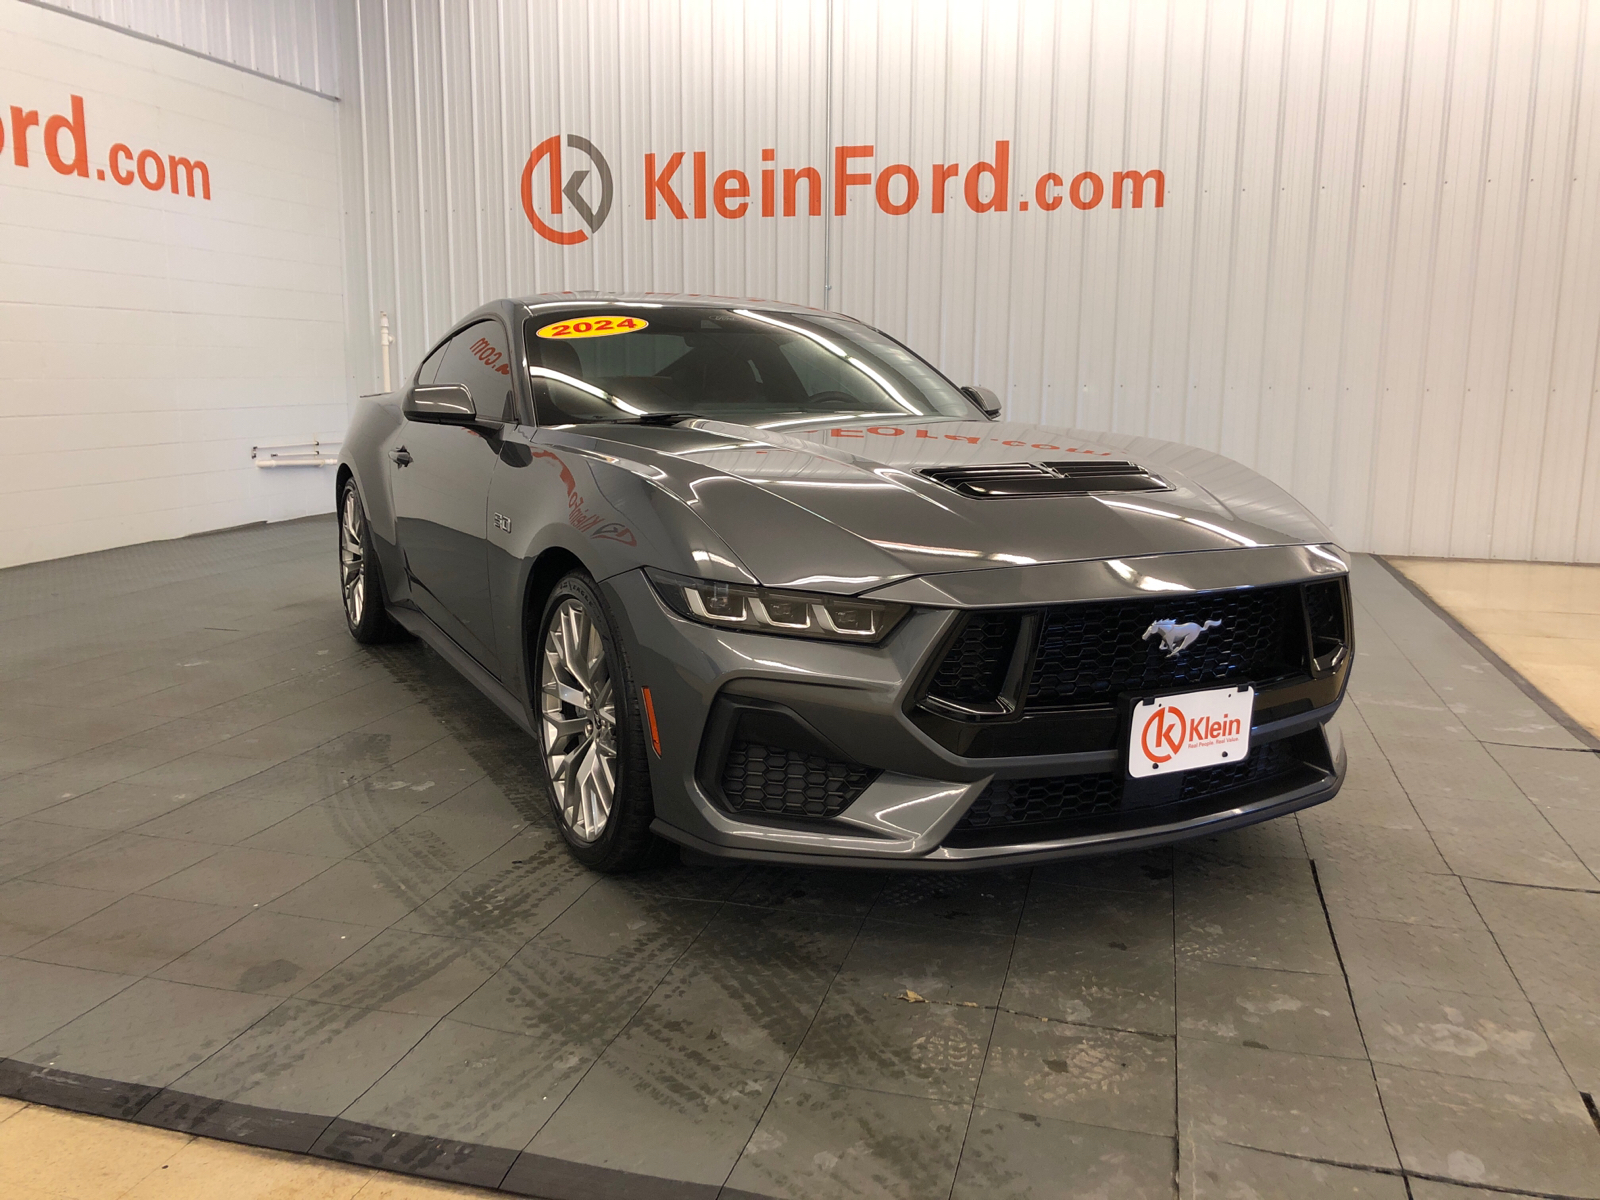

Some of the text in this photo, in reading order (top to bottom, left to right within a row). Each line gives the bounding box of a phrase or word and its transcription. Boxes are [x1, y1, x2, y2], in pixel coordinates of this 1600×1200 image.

[0, 94, 211, 200] rd.com
[644, 140, 1165, 220] KleinFord.com
[551, 318, 637, 337] 2024
[1188, 713, 1241, 742] Klein
